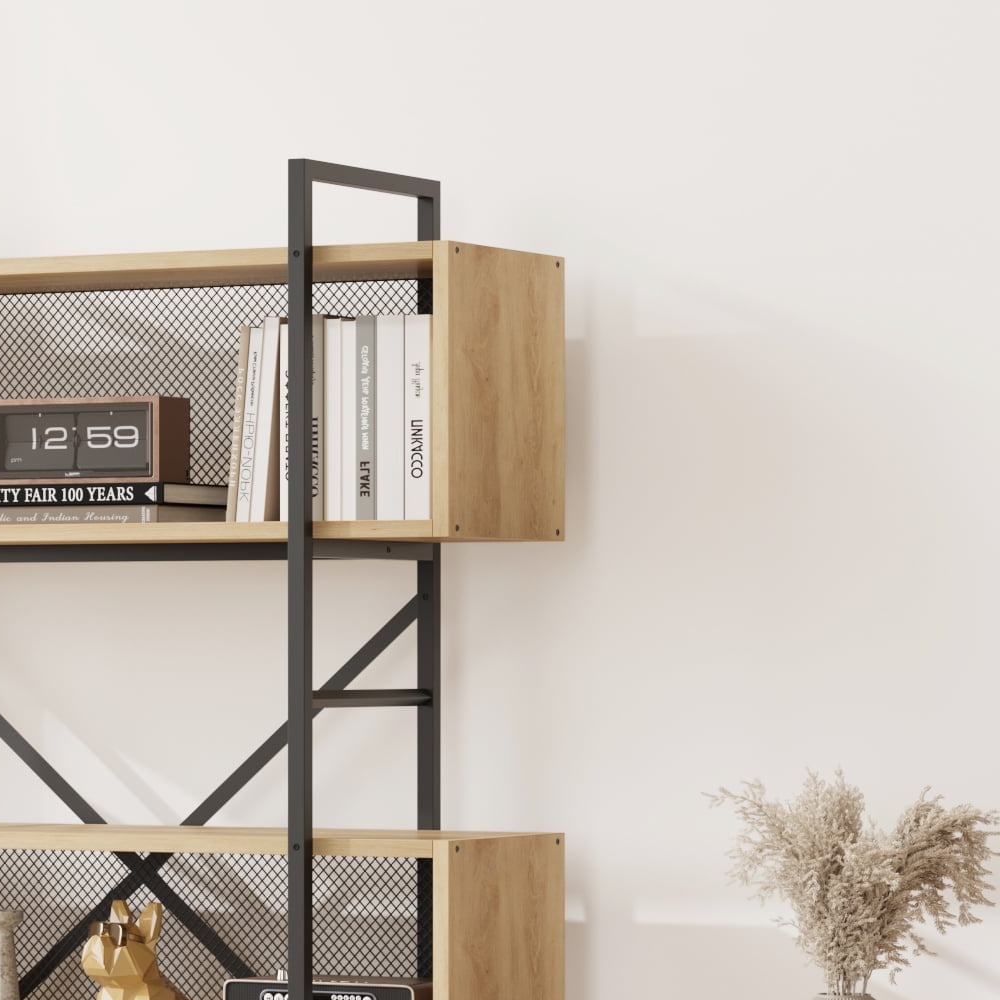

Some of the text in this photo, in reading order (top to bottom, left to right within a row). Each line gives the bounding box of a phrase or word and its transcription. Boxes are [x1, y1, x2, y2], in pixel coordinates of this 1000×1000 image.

[24, 488, 57, 503] FAIR
[61, 488, 84, 502] 100
[87, 486, 134, 502] YEARS
[16, 512, 37, 522] and
[41, 512, 79, 522] Indian
[84, 512, 129, 523] Housing
